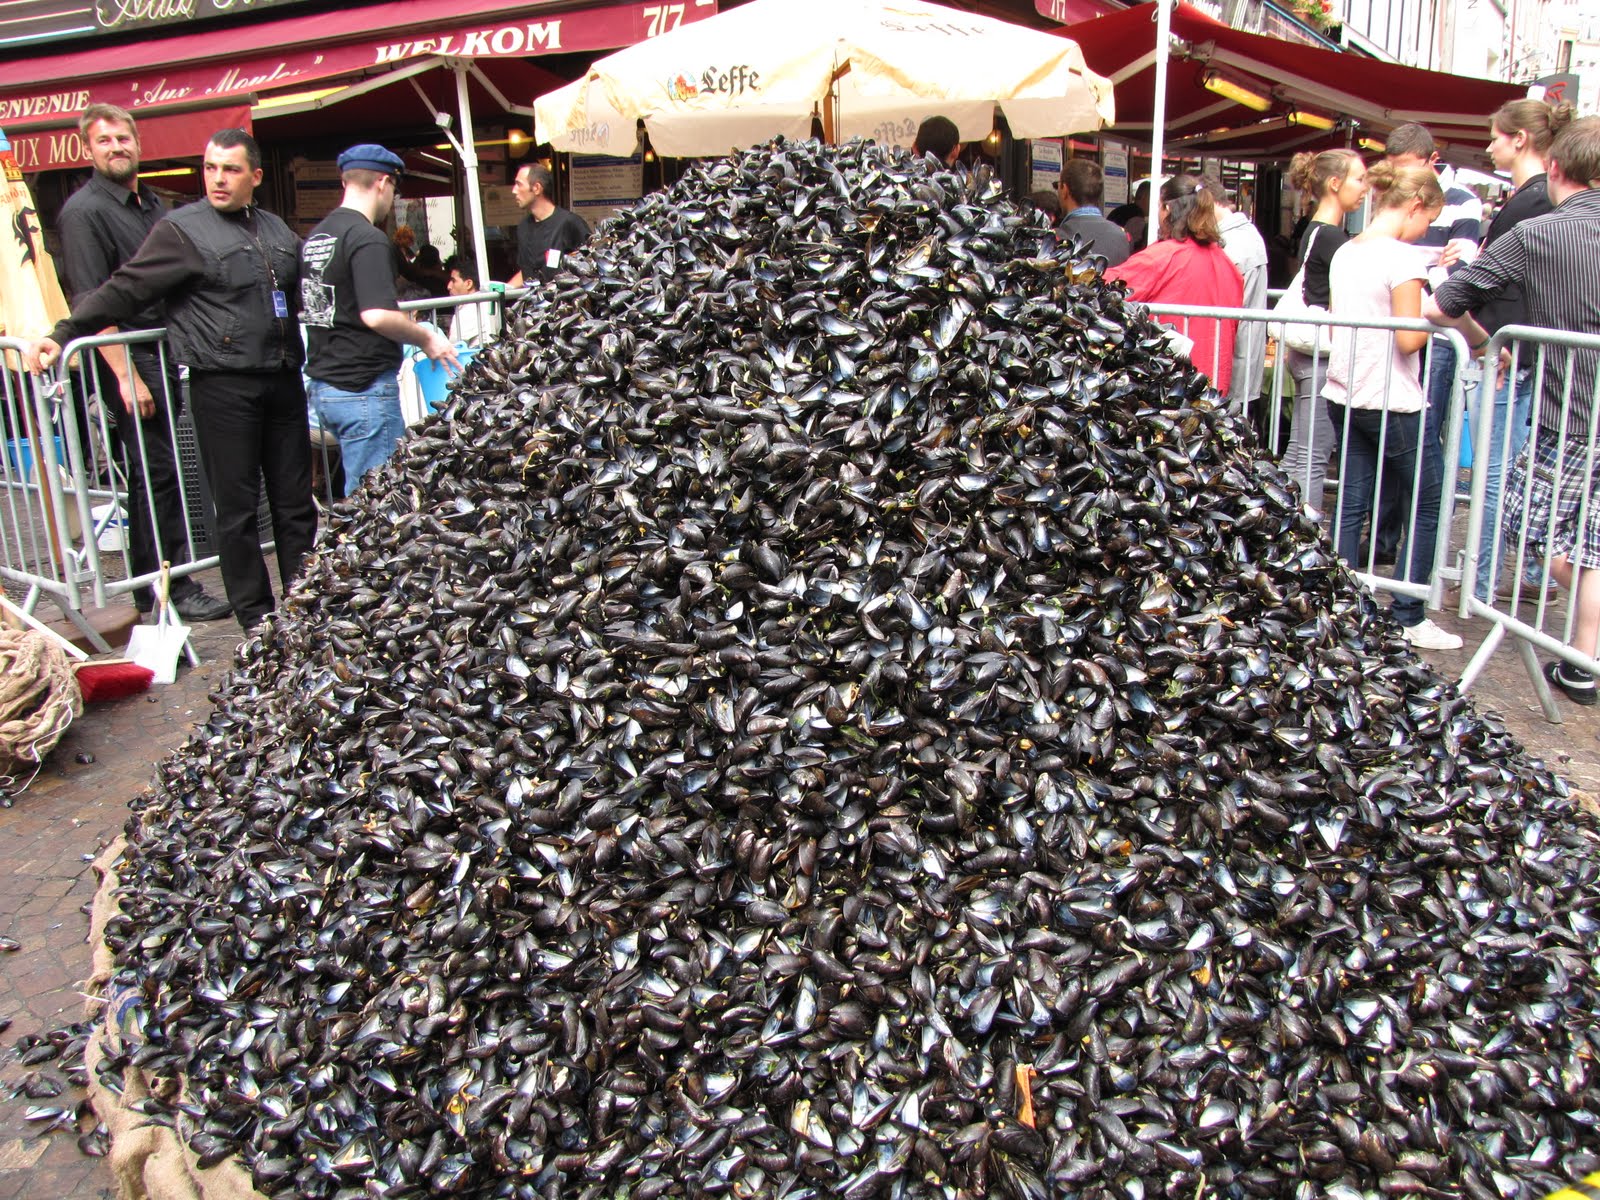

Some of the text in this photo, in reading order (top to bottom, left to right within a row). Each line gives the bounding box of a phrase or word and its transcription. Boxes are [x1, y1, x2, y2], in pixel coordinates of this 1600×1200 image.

[375, 20, 562, 63] WELKOM
[700, 64, 760, 96] Leffe
[13, 138, 40, 168] UX
